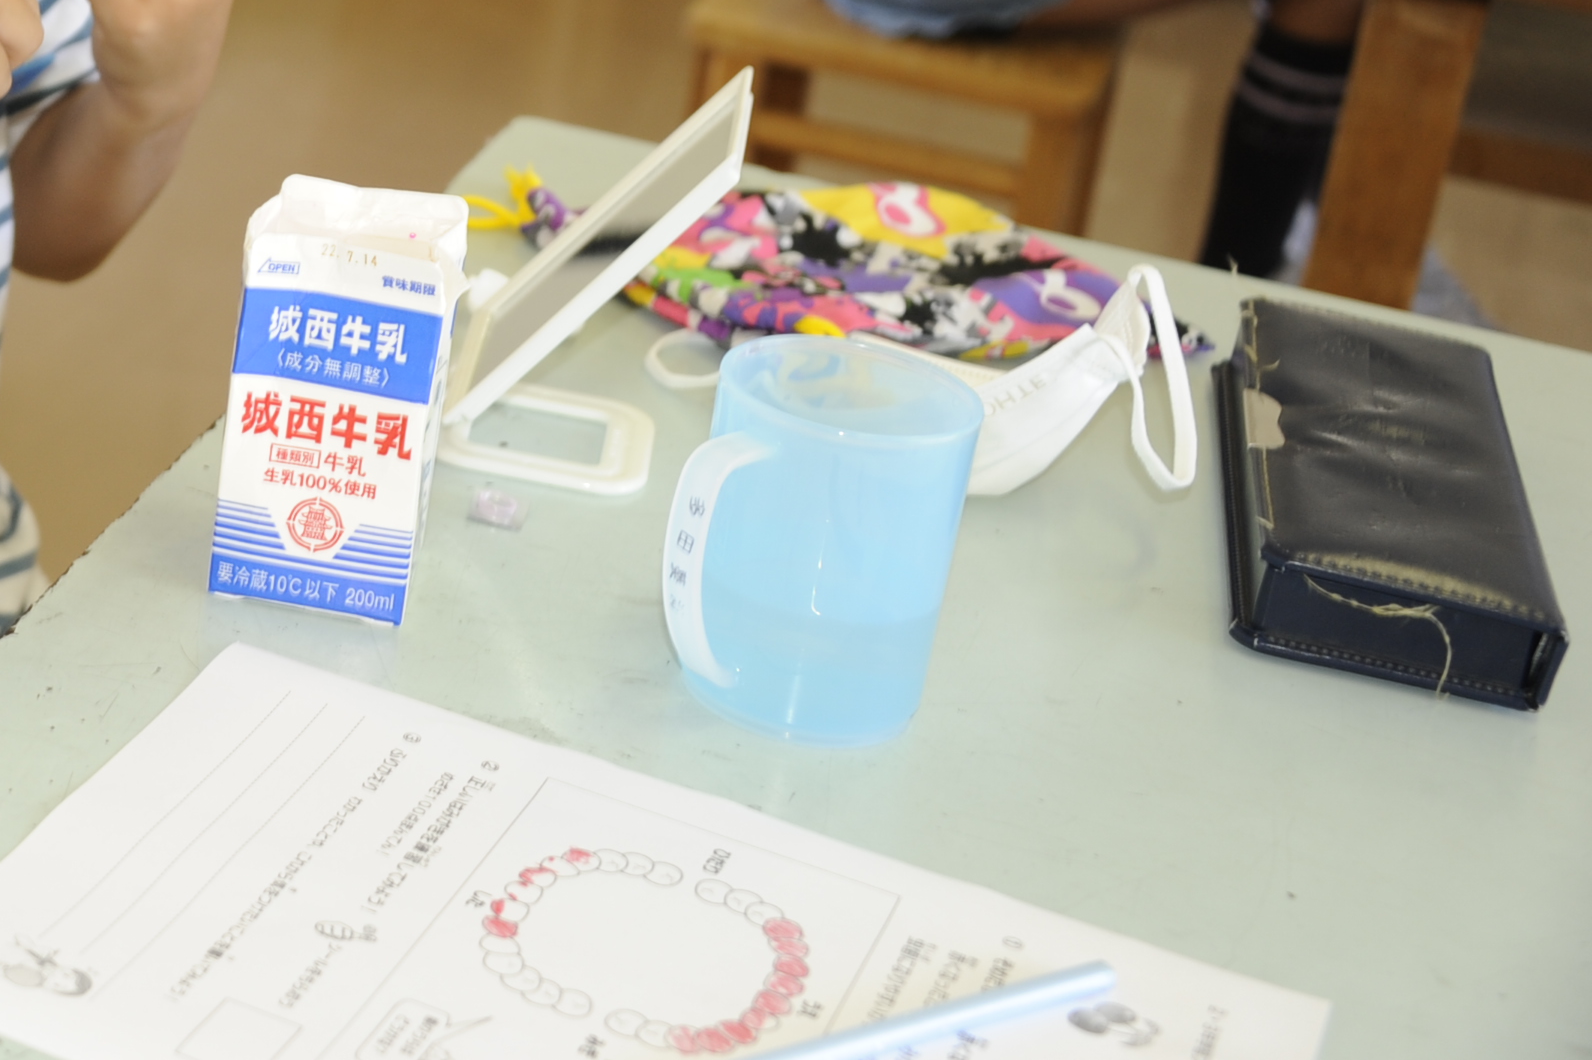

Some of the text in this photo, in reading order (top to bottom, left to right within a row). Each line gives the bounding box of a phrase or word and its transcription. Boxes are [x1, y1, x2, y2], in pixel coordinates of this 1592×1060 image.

[267, 262, 296, 273] OPEN
[382, 275, 436, 296] 賞味期限
[268, 304, 408, 365] 城西牛乳
[241, 391, 412, 461] 城西牛乳
[276, 447, 367, 477] 種類別 牛乳
[263, 467, 377, 500] 生乳100%使用
[344, 587, 396, 612] 200ml
